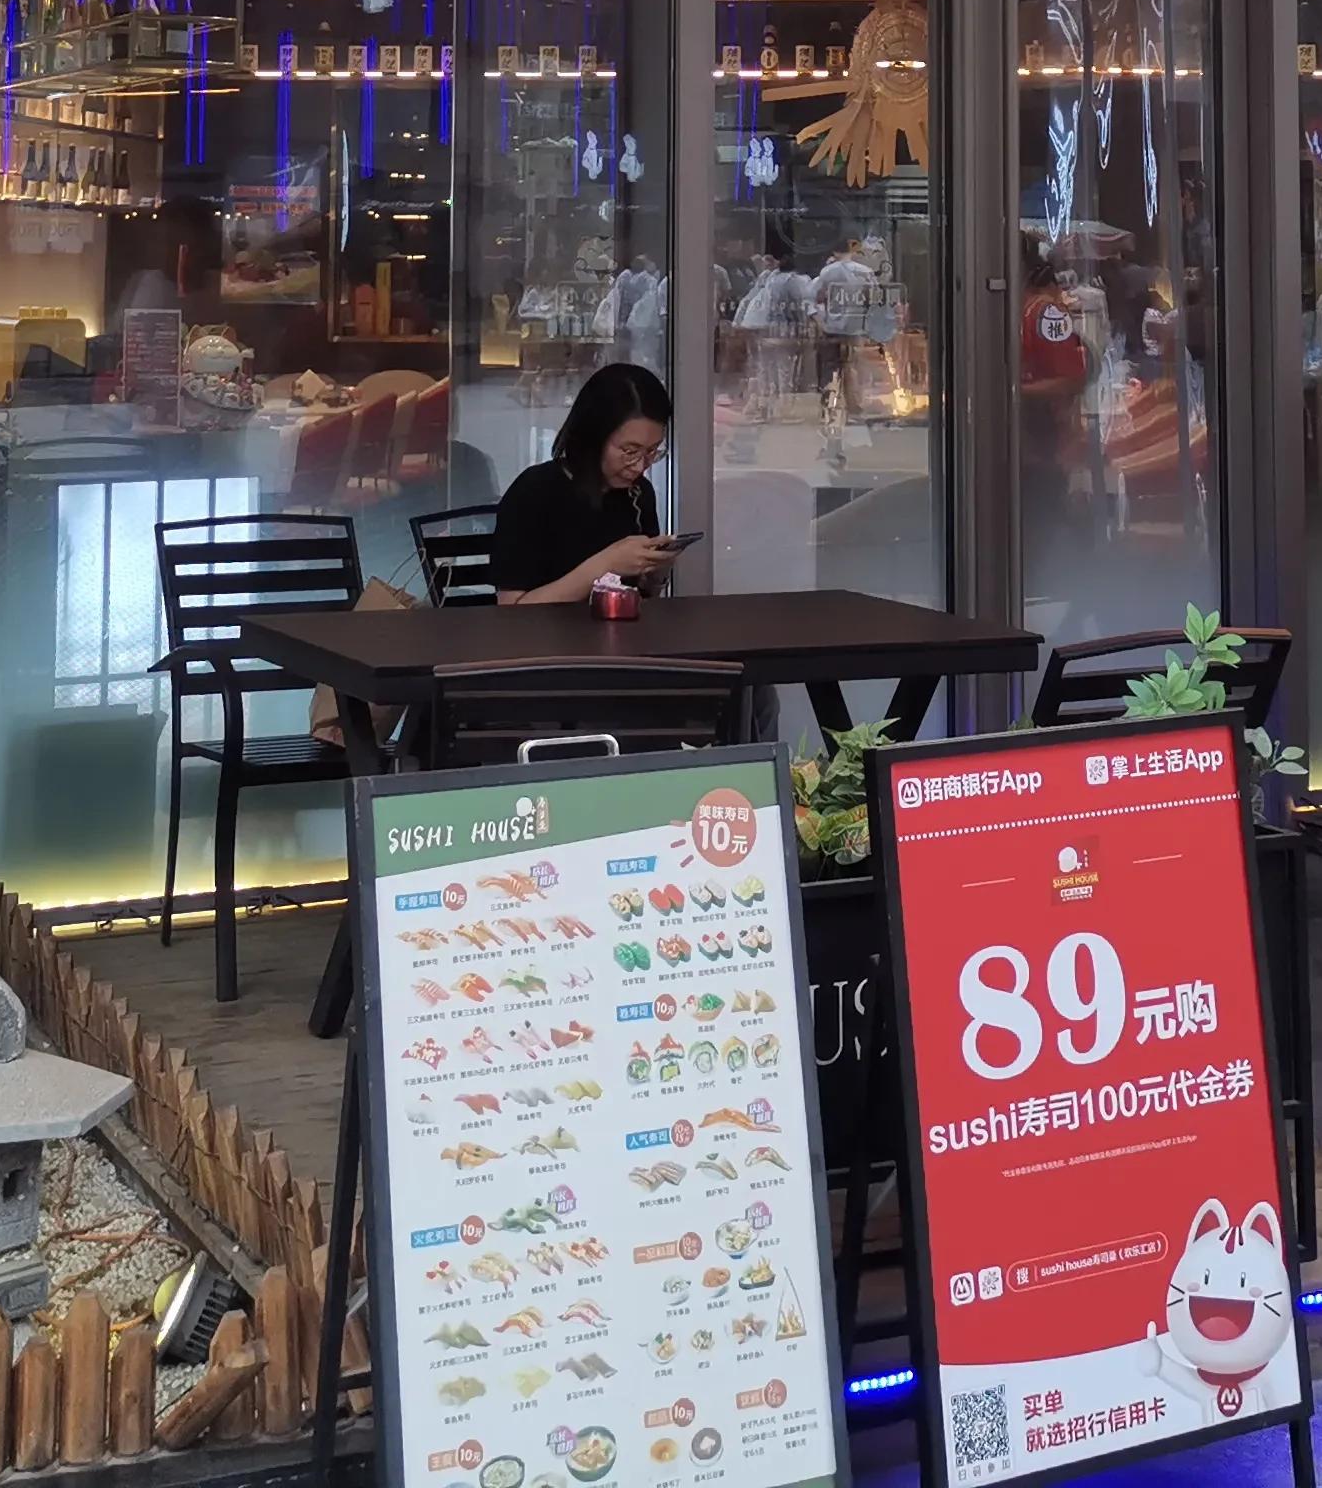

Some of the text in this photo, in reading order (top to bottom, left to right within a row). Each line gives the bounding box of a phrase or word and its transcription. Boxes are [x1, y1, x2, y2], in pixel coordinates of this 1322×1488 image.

[1110, 747, 1224, 781] 掌上生活App
[922, 767, 1043, 803] 招商银行App
[697, 804, 751, 822] 美味寿司
[387, 815, 536, 855] SUSHI HOUSE
[697, 820, 750, 855] 10元
[928, 1057, 1255, 1156] sushi寿司100元代金券
[461, 1221, 484, 1240] 10元
[1022, 1389, 1065, 1421] 买单
[1025, 1396, 1168, 1453] 就选招行信用卡
[459, 1446, 482, 1464] 10元
